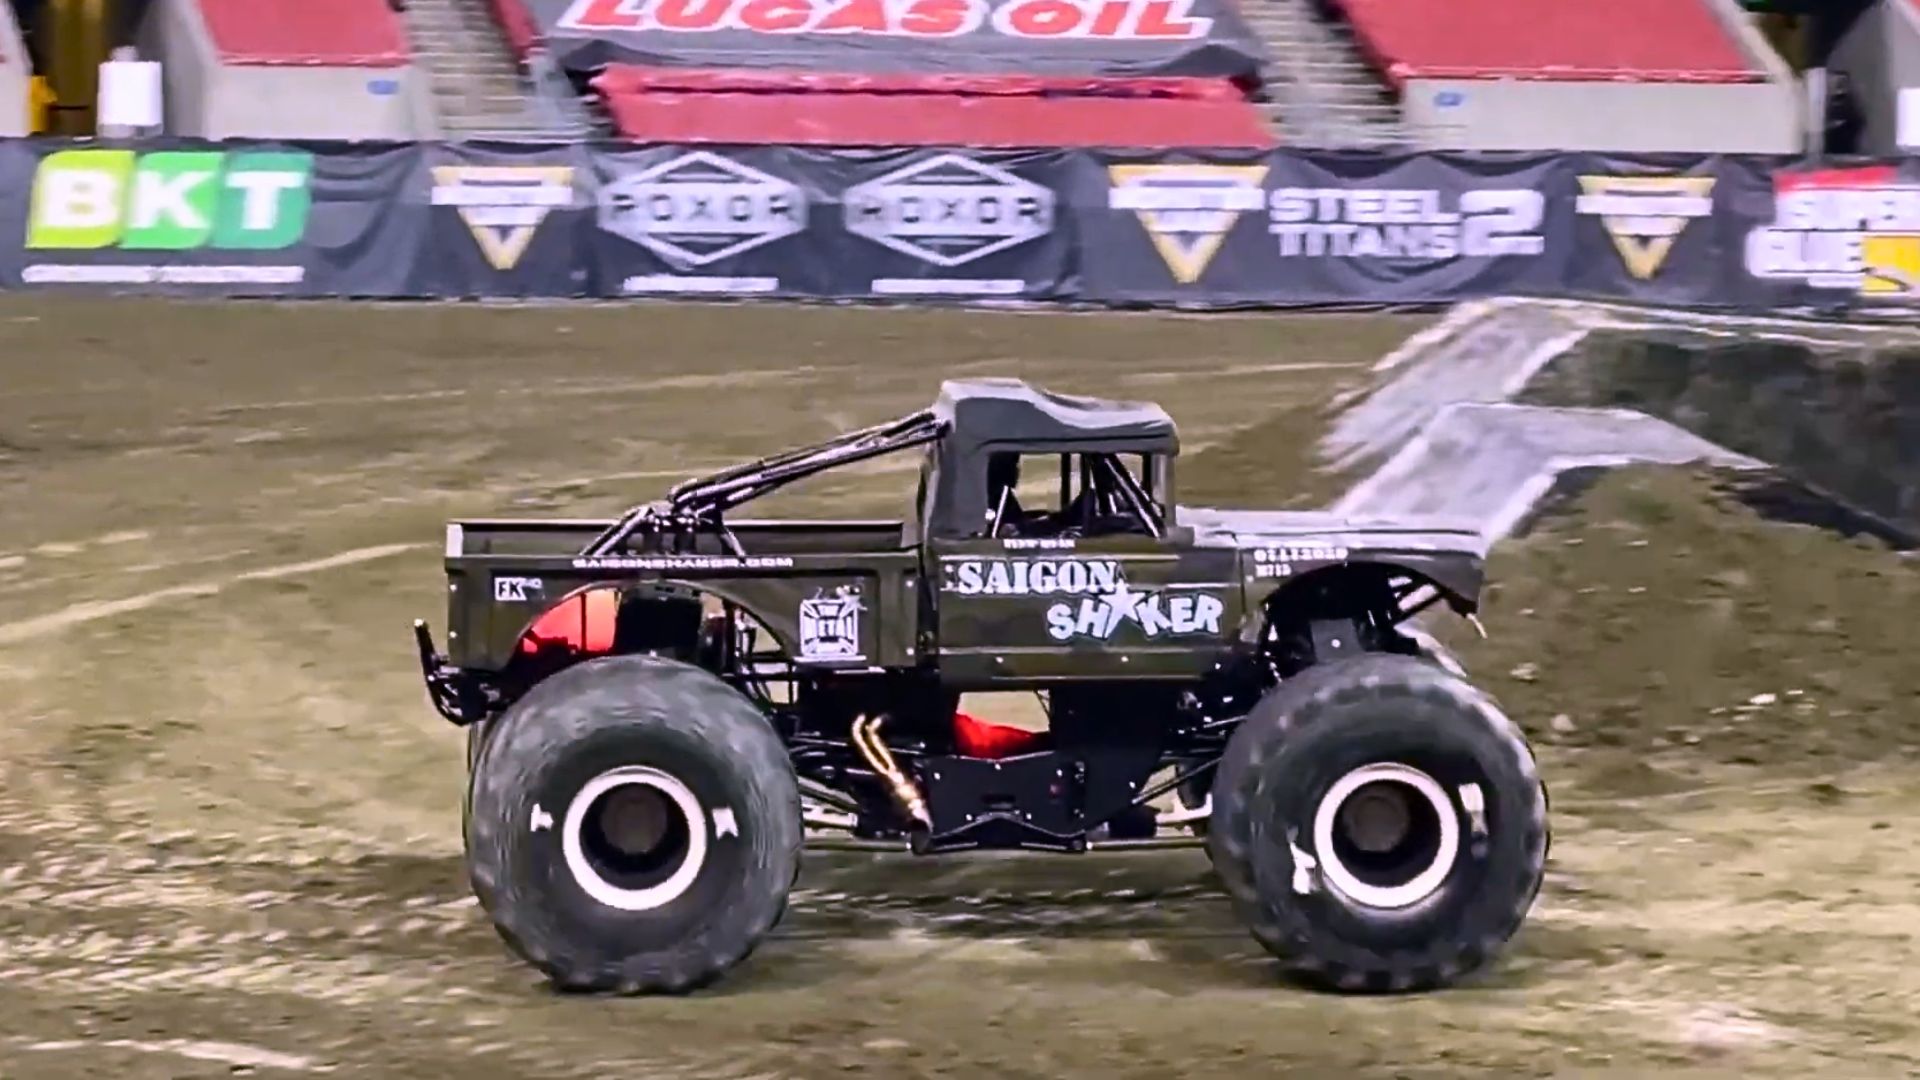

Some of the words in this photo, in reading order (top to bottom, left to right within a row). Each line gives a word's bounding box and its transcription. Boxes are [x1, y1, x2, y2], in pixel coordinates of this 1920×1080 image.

[556, 0, 990, 36] LUCAS
[993, 0, 1214, 39] OIL
[42, 169, 304, 230] BKT
[602, 188, 803, 228] ROXOR
[850, 190, 1051, 230] ROXOR
[1269, 188, 1460, 222] STEEL
[1268, 223, 1460, 259] TITANS
[1459, 188, 1544, 256] 2
[957, 560, 1120, 594] SAIGON
